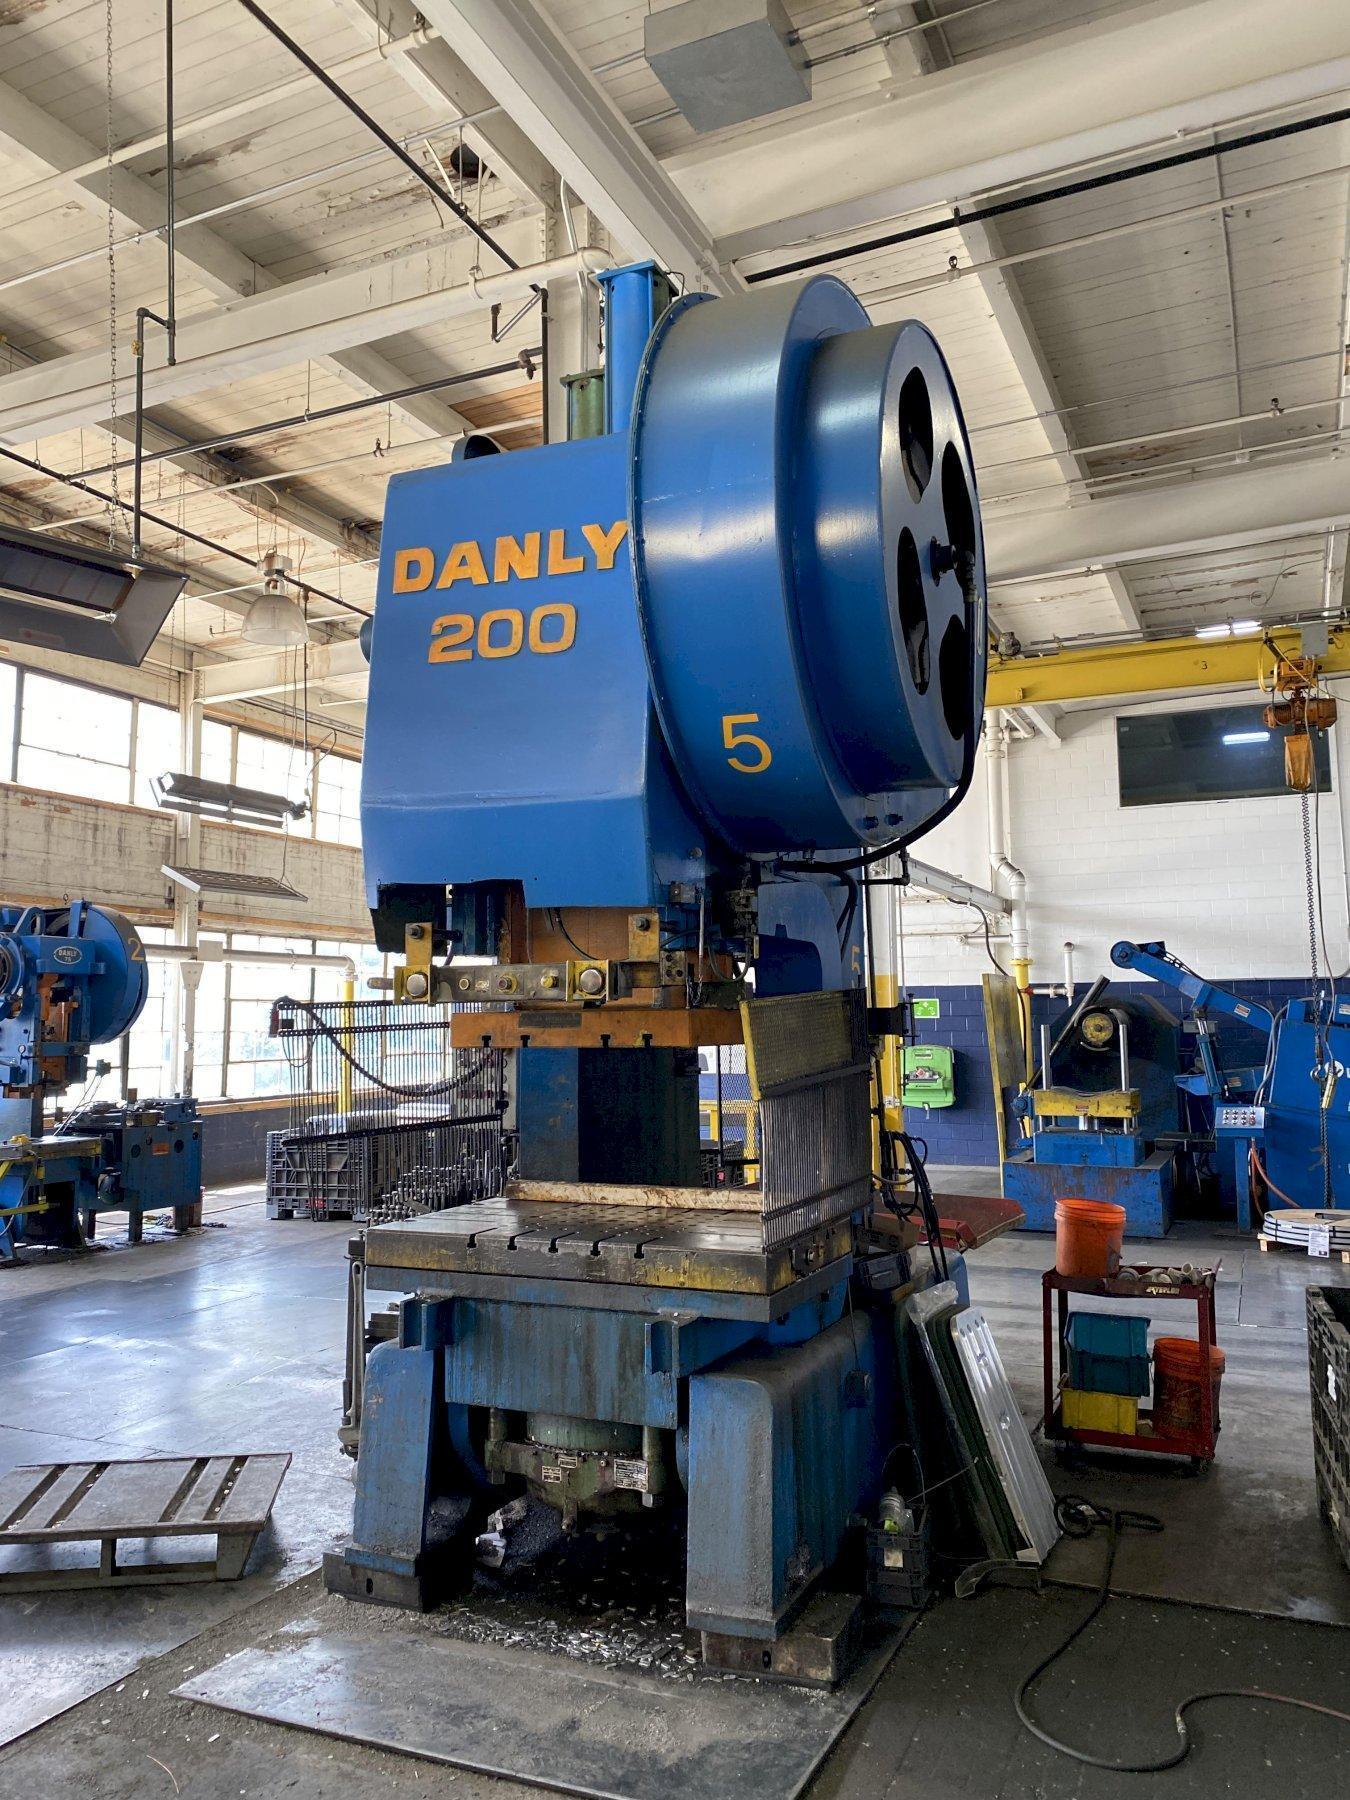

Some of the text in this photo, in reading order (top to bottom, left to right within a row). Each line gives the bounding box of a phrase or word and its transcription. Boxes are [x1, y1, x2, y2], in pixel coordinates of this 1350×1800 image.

[393, 520, 629, 594] DANLY
[428, 603, 578, 664] 200
[722, 713, 772, 773] 5
[58, 949, 77, 957] DANLY
[127, 937, 144, 961] 2
